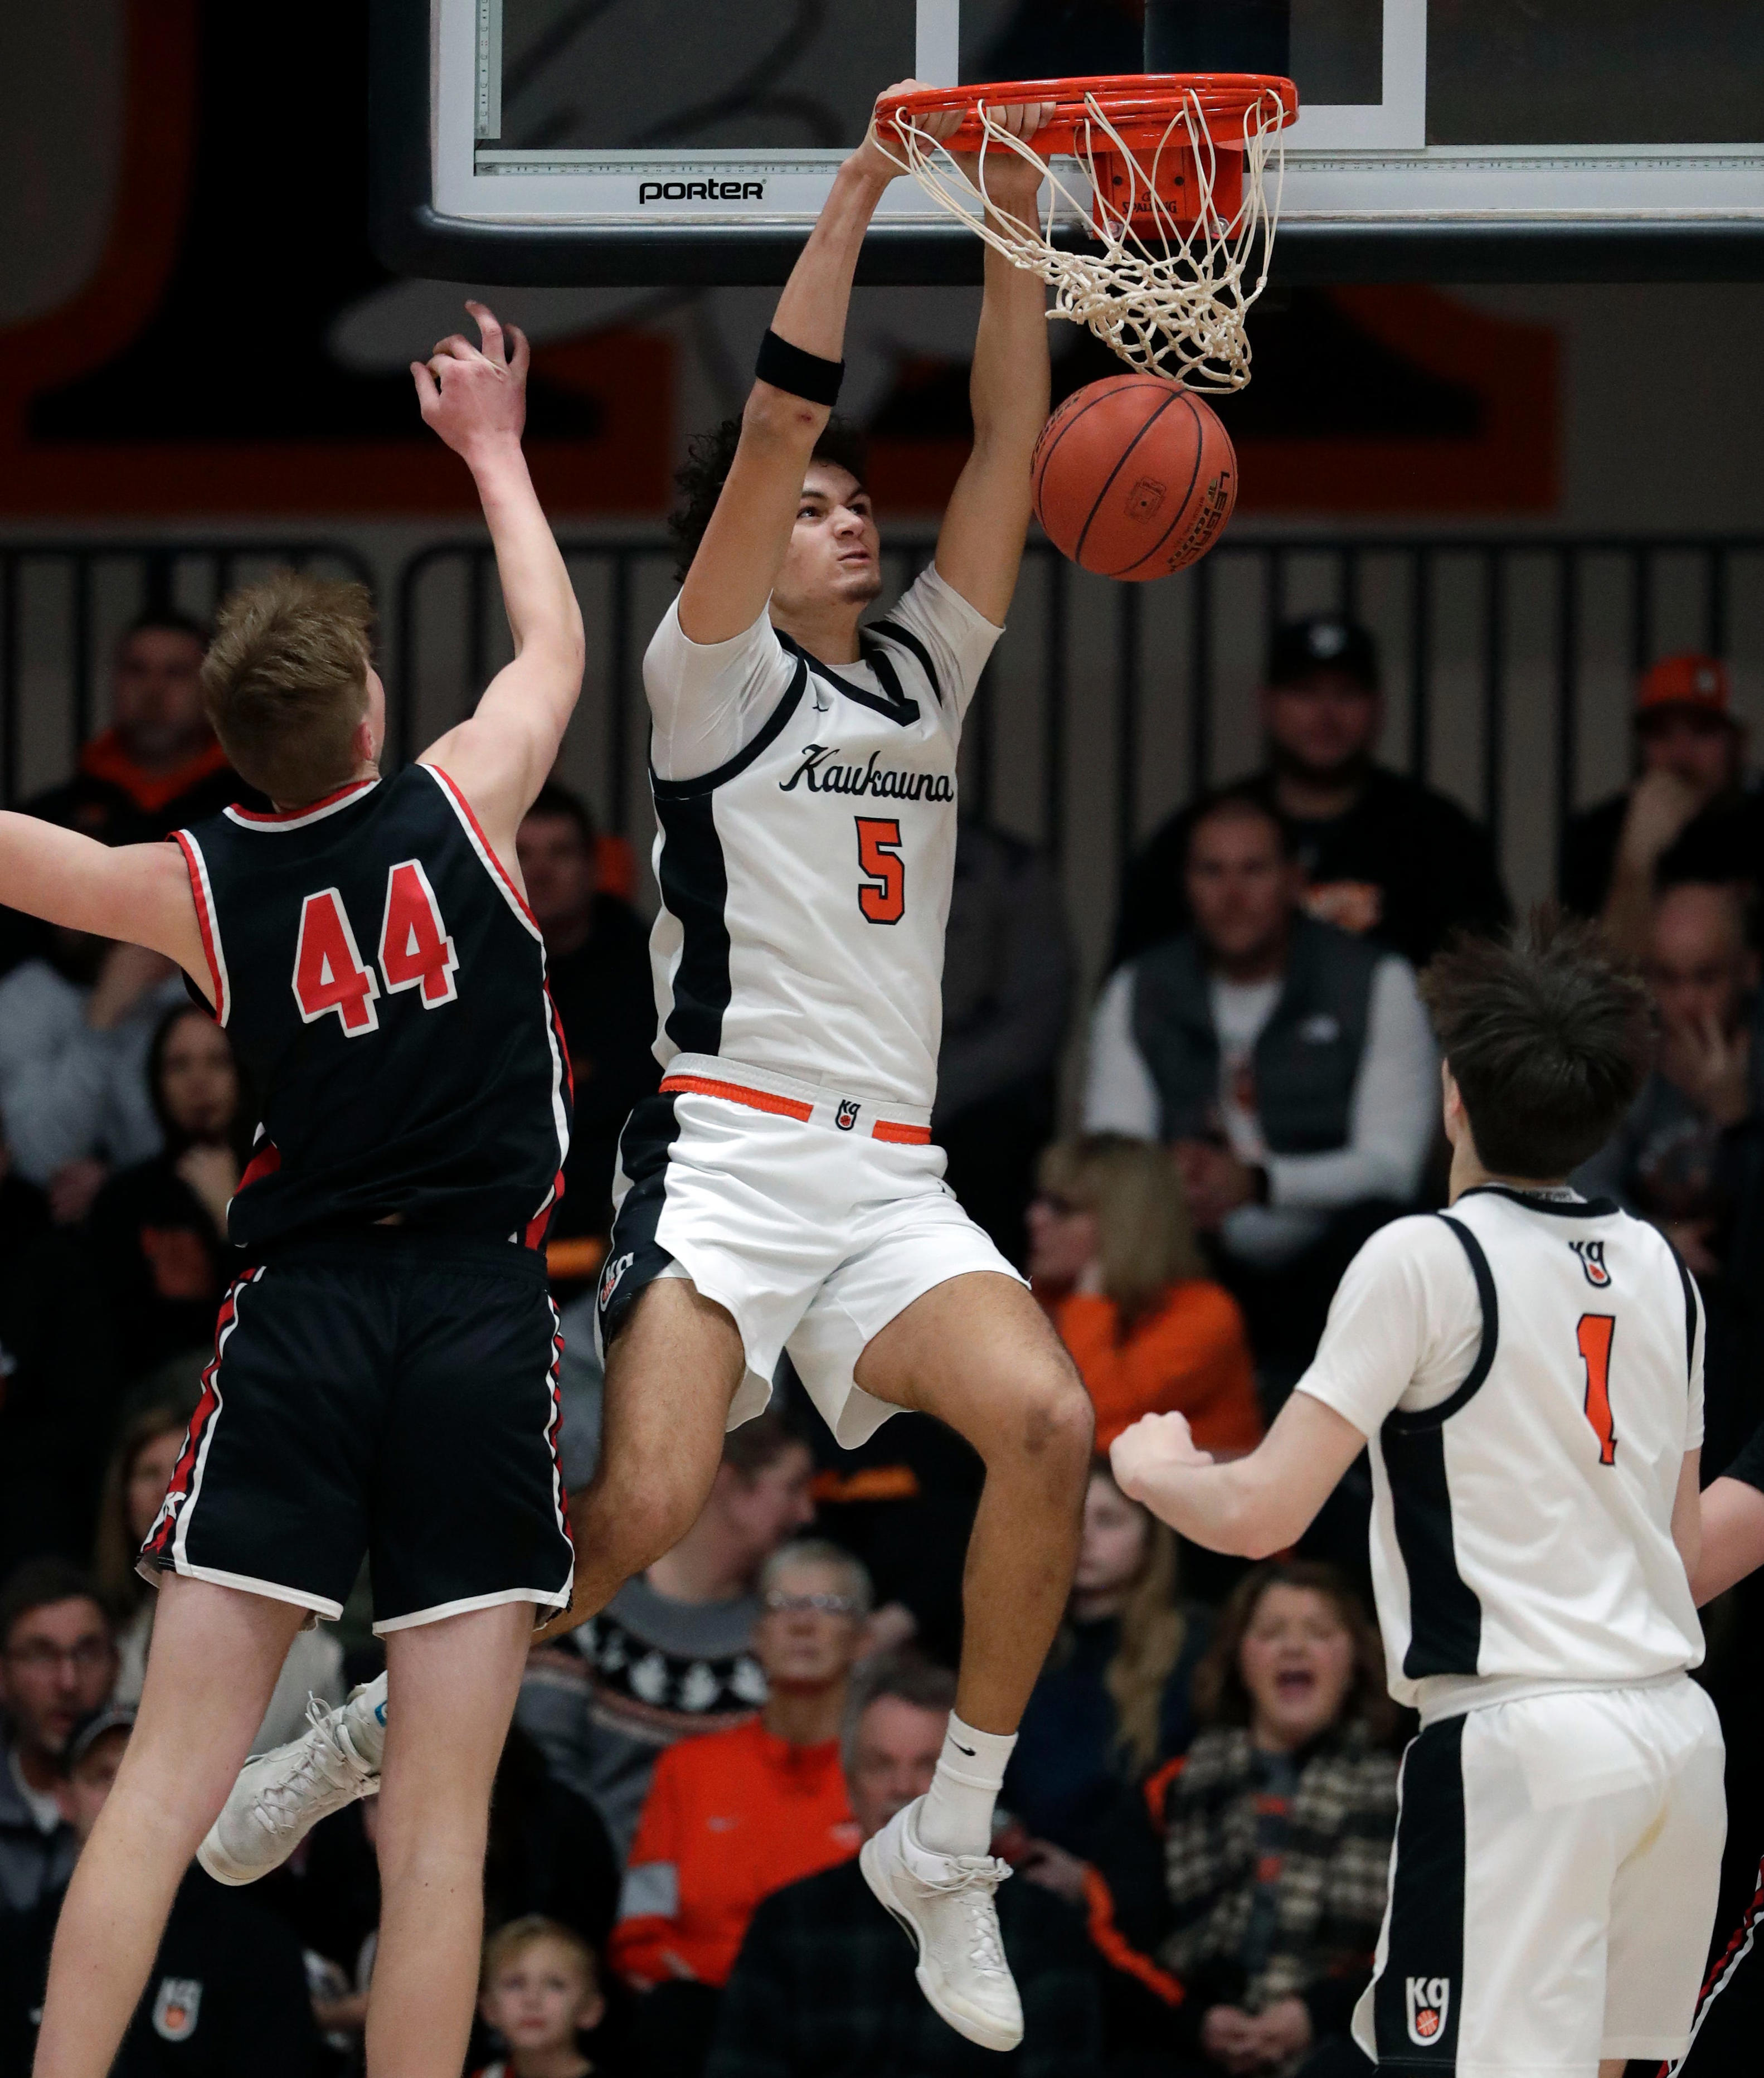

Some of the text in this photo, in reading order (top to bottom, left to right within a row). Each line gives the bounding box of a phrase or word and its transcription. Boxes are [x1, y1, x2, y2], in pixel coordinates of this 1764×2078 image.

[779, 744, 954, 803] Kaukauna
[854, 815, 905, 925] 5
[291, 858, 460, 1038] 44
[1577, 1313, 1617, 1466] 1
